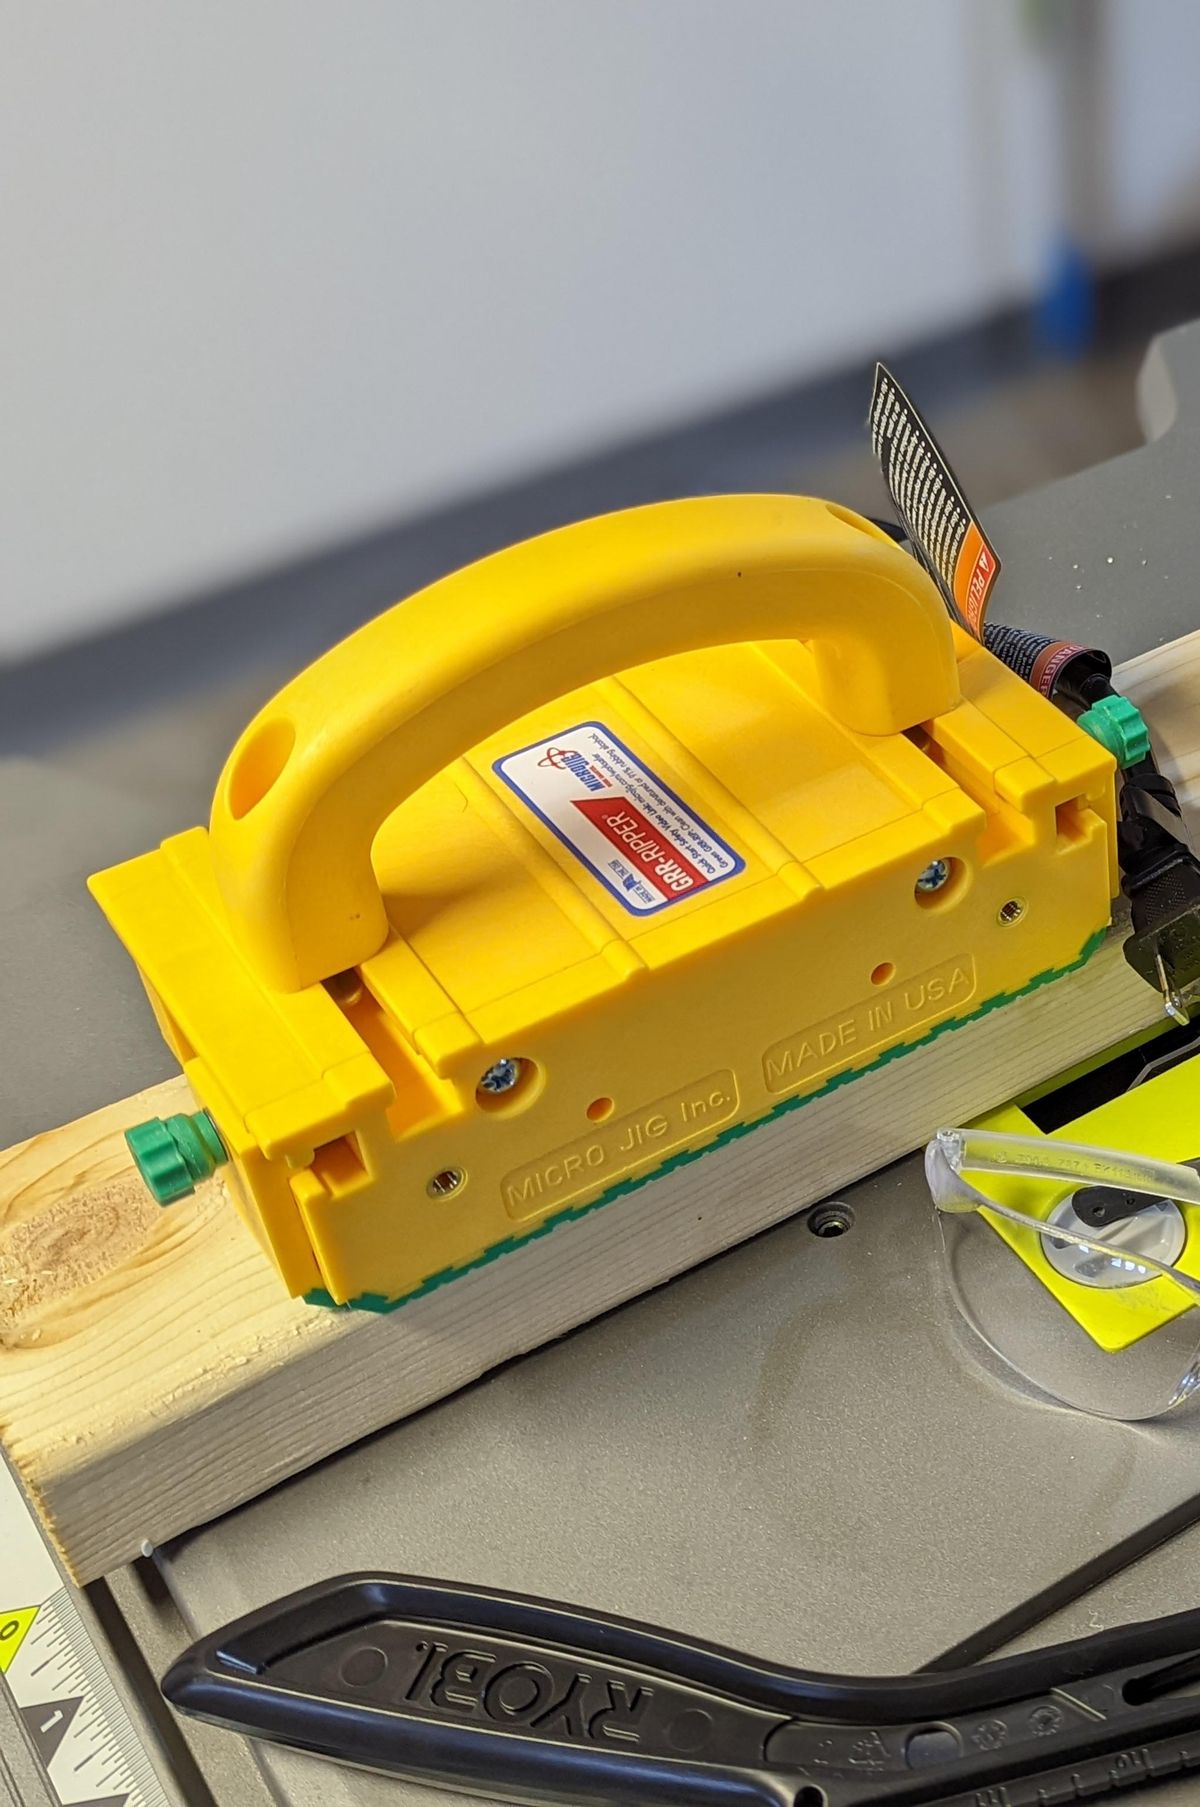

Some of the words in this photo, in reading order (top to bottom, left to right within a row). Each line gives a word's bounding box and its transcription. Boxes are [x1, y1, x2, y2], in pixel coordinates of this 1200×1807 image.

[604, 811, 695, 892] GRR-RIPPER
[767, 1020, 857, 1083] MADE
[868, 1005, 894, 1032] IN
[905, 967, 971, 1012] USA
[506, 1144, 606, 1208] MICRO
[619, 1114, 669, 1153] JIG
[681, 1090, 733, 1122] Inc.
[40, 1710, 64, 1734] 1
